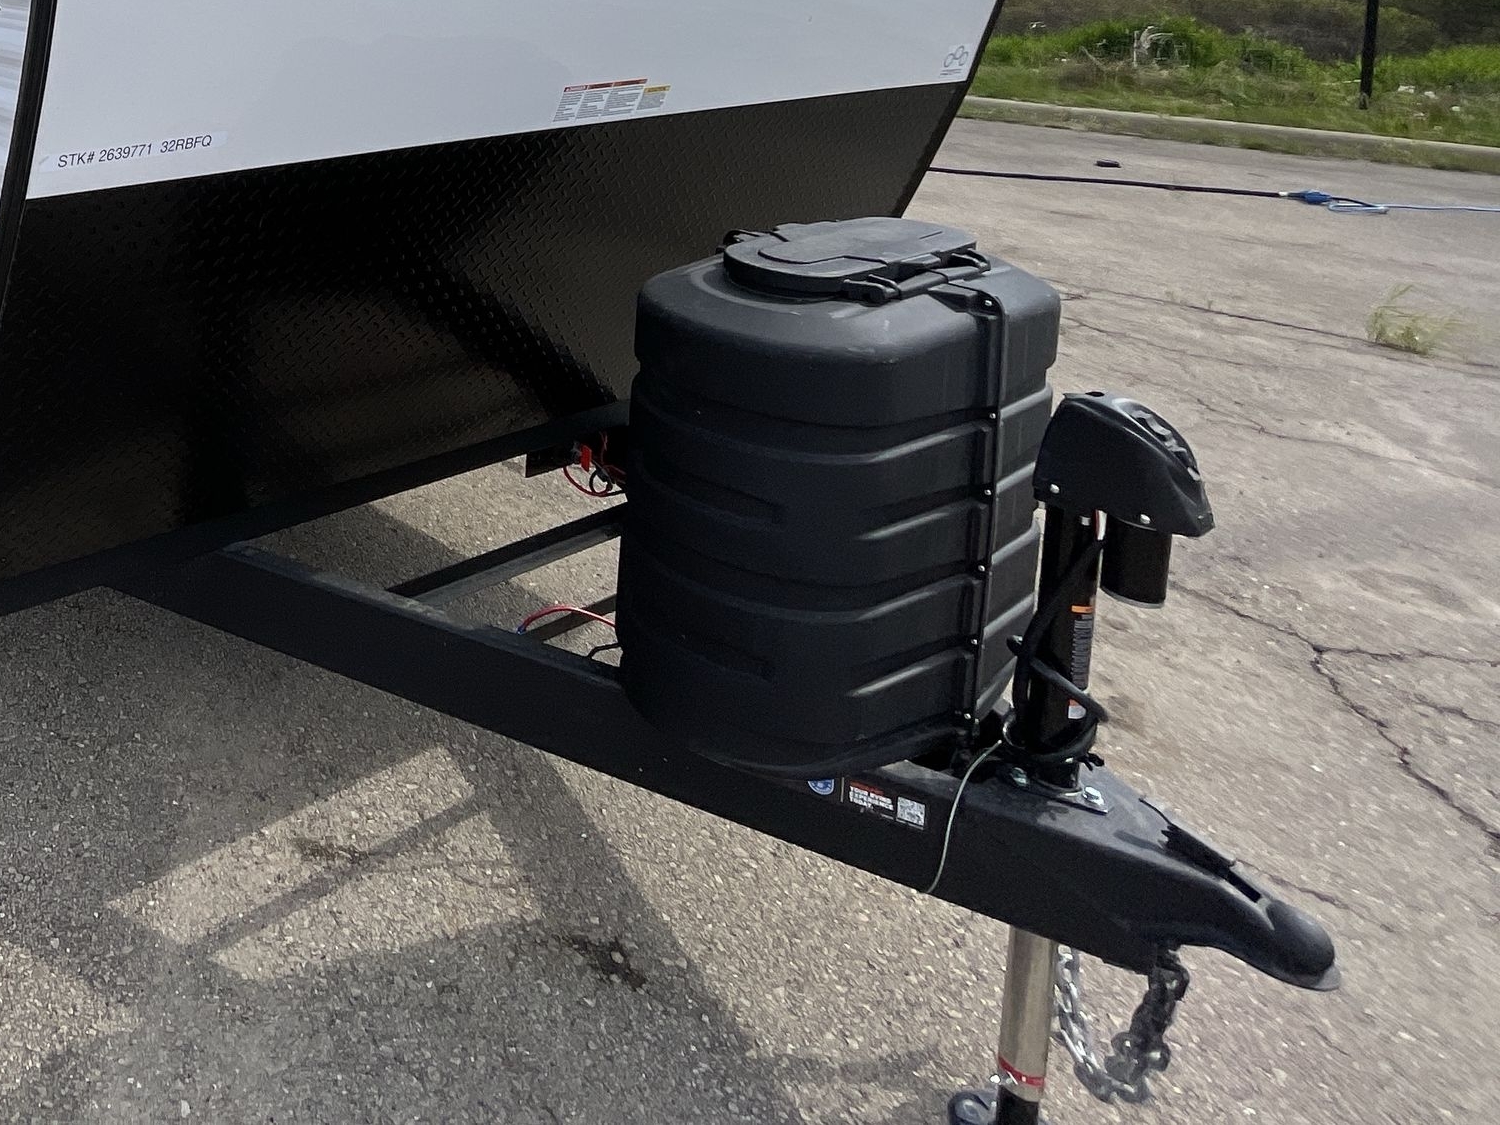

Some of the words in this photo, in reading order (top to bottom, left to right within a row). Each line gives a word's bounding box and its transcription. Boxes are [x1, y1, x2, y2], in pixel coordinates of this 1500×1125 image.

[57, 151, 95, 168] STK#
[98, 142, 153, 163] 2639771
[159, 134, 213, 154] 32RBFQ
